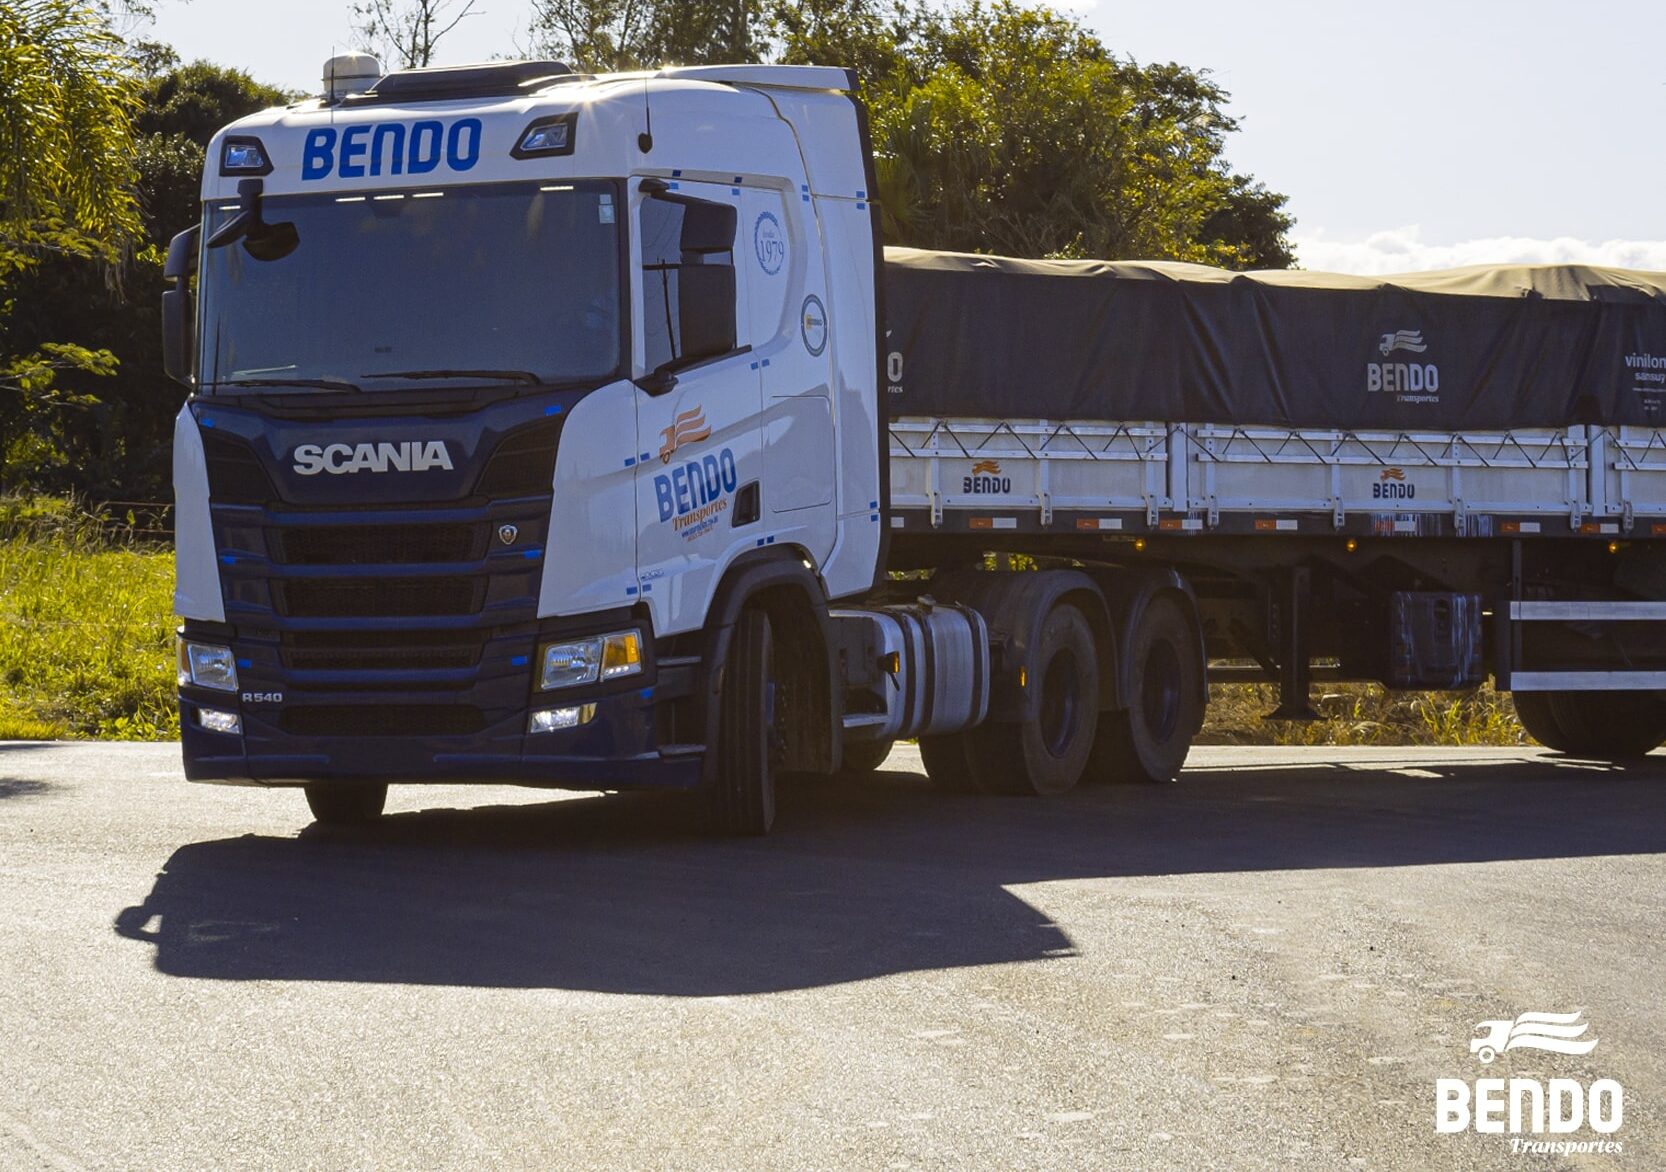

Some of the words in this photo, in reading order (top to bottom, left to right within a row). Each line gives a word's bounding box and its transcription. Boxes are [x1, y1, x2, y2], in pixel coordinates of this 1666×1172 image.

[302, 118, 482, 181] BENDO
[760, 240, 784, 263] 1979
[1367, 363, 1439, 392] BENDO
[293, 440, 454, 475] SCANIA
[654, 447, 737, 523] BENDO
[672, 498, 728, 531] Transportes
